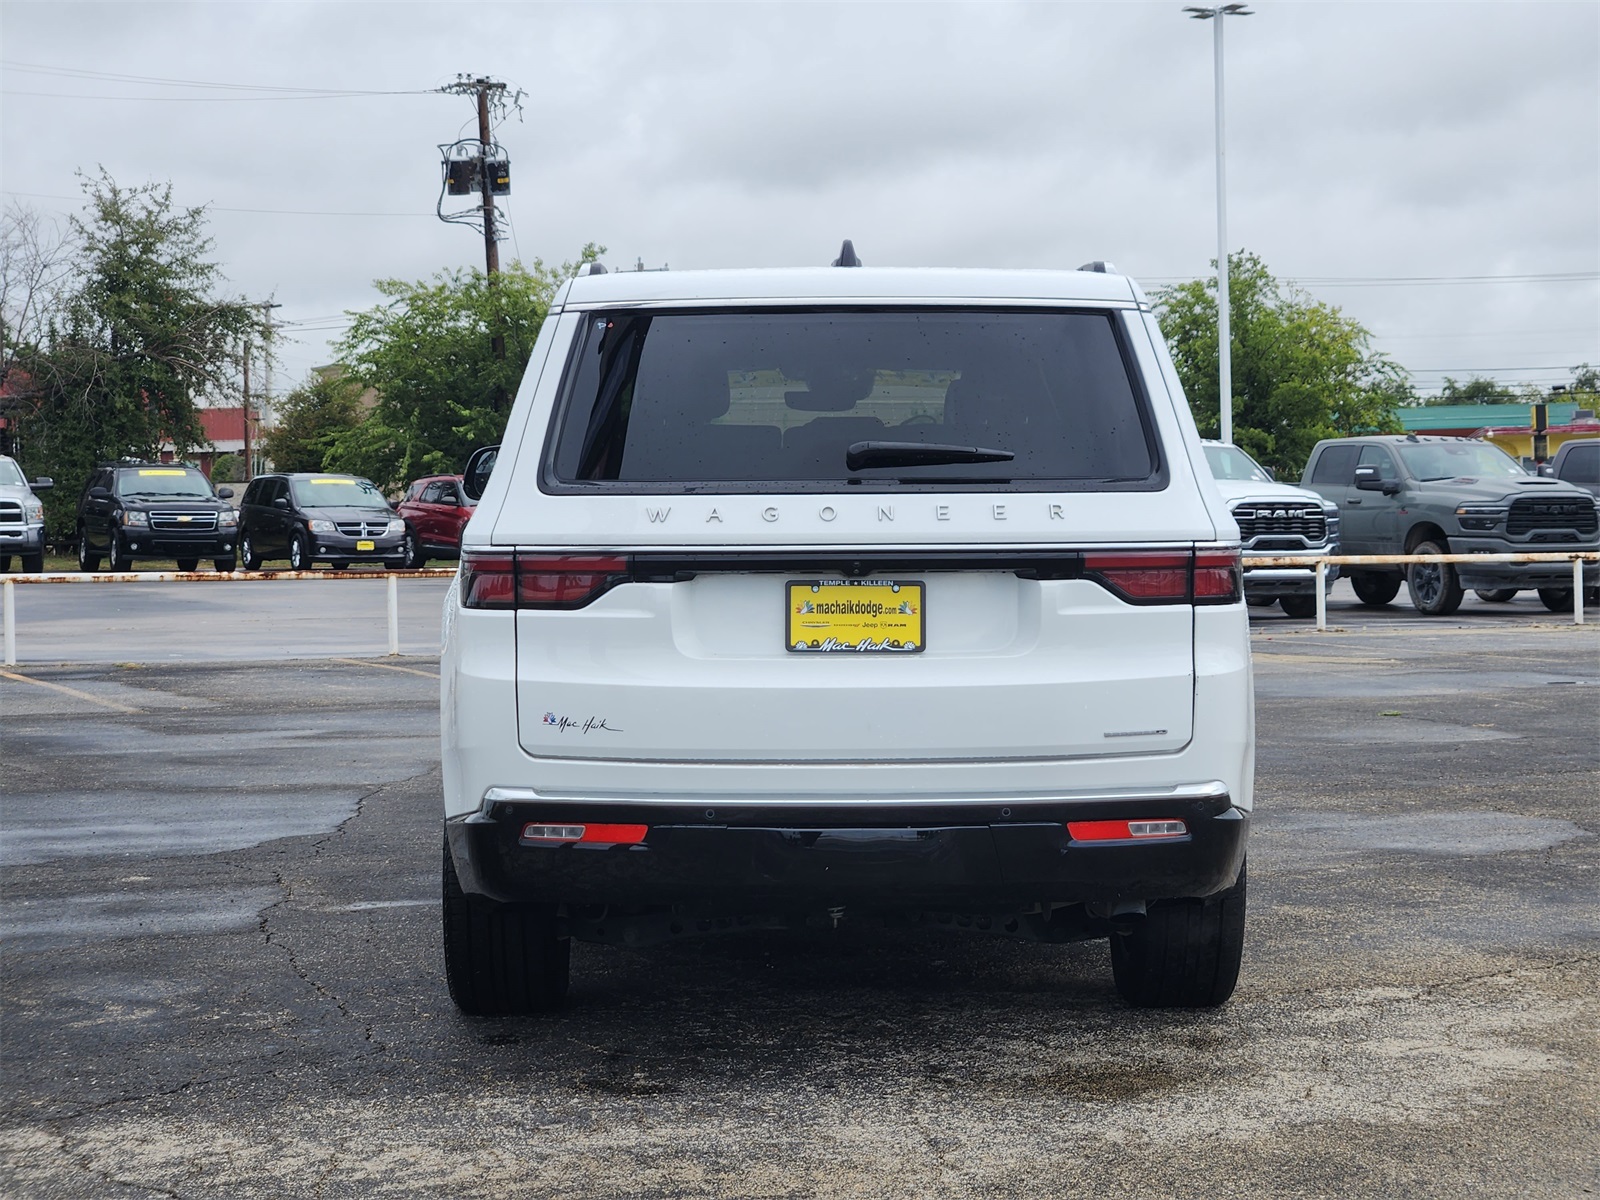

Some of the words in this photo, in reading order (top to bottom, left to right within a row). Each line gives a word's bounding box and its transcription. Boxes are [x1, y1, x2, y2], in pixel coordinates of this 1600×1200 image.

[646, 504, 1065, 523] WAGONEER
[1257, 509, 1303, 518] RAM
[1533, 505, 1578, 514] RAM
[816, 600, 897, 618] machaikdodge.com
[862, 621, 878, 629] Jeep
[819, 637, 855, 652] Mac
[856, 637, 900, 652] Haik
[558, 716, 580, 733] Mac
[582, 716, 618, 734] Haik
